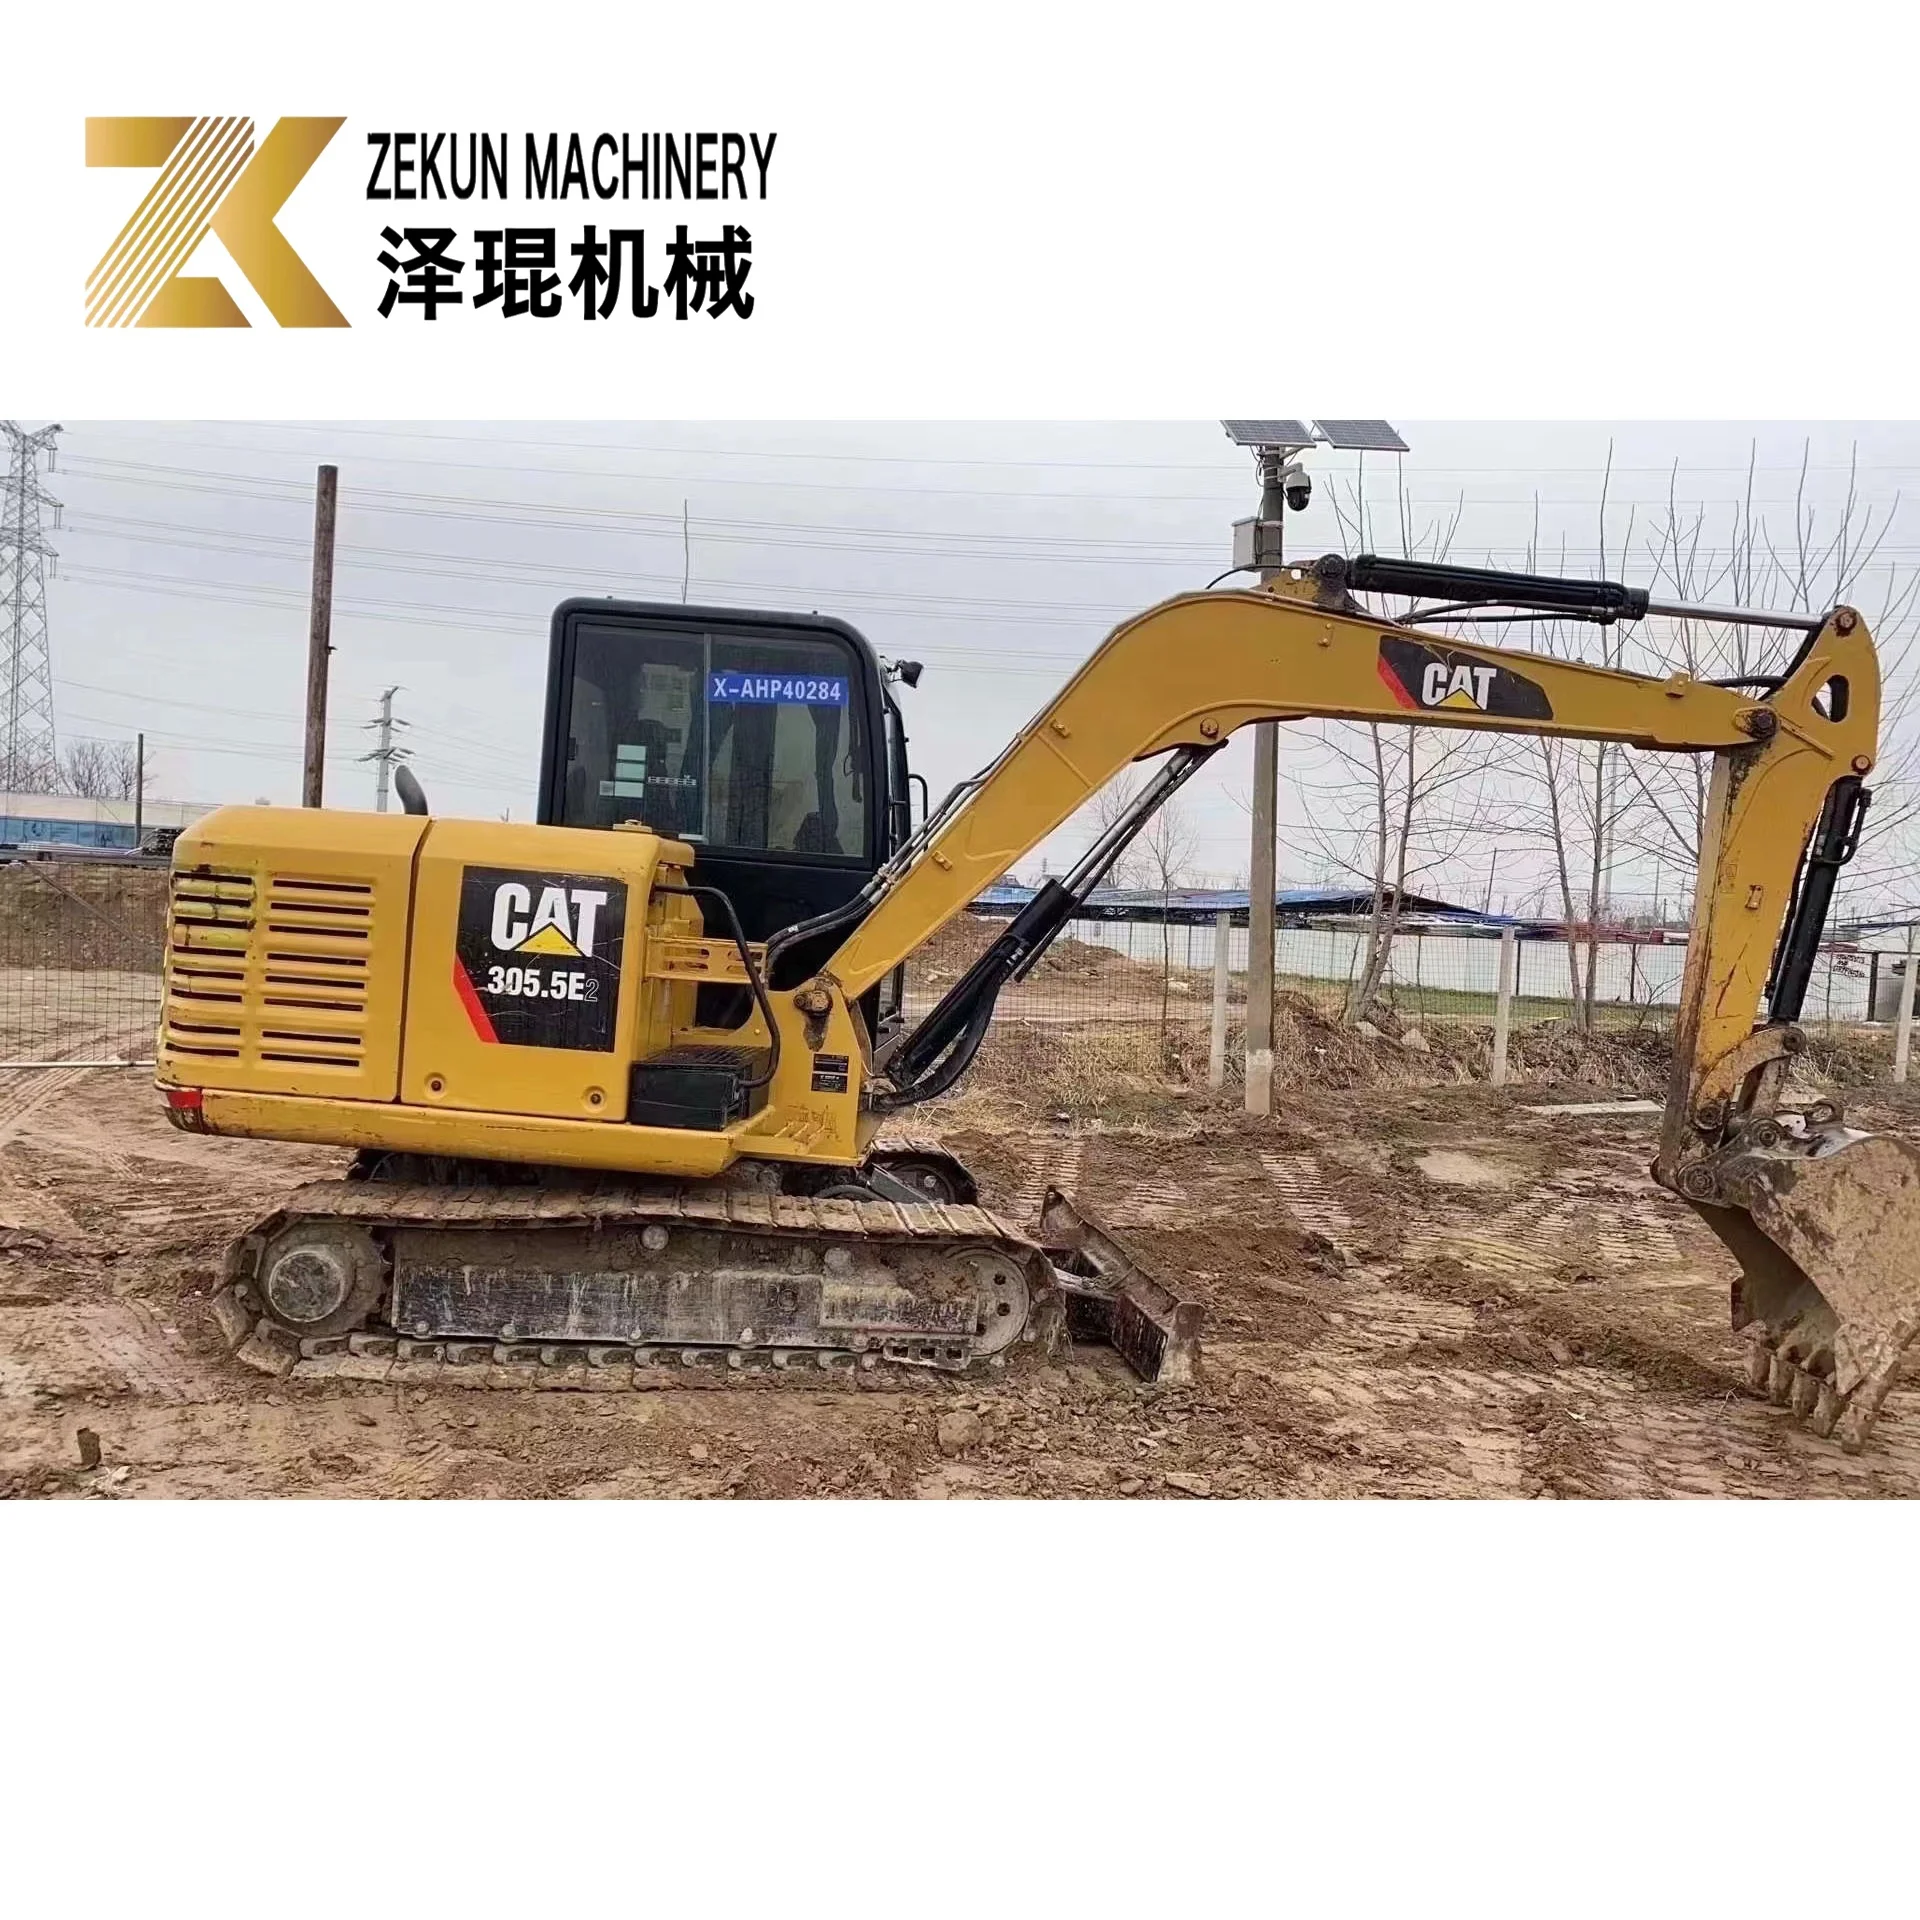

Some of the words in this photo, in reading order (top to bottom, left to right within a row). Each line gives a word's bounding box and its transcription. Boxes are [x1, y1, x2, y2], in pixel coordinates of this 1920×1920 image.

[713, 678, 841, 700] X-AHP40284
[1422, 662, 1497, 711] CAT
[491, 883, 608, 958] CAT
